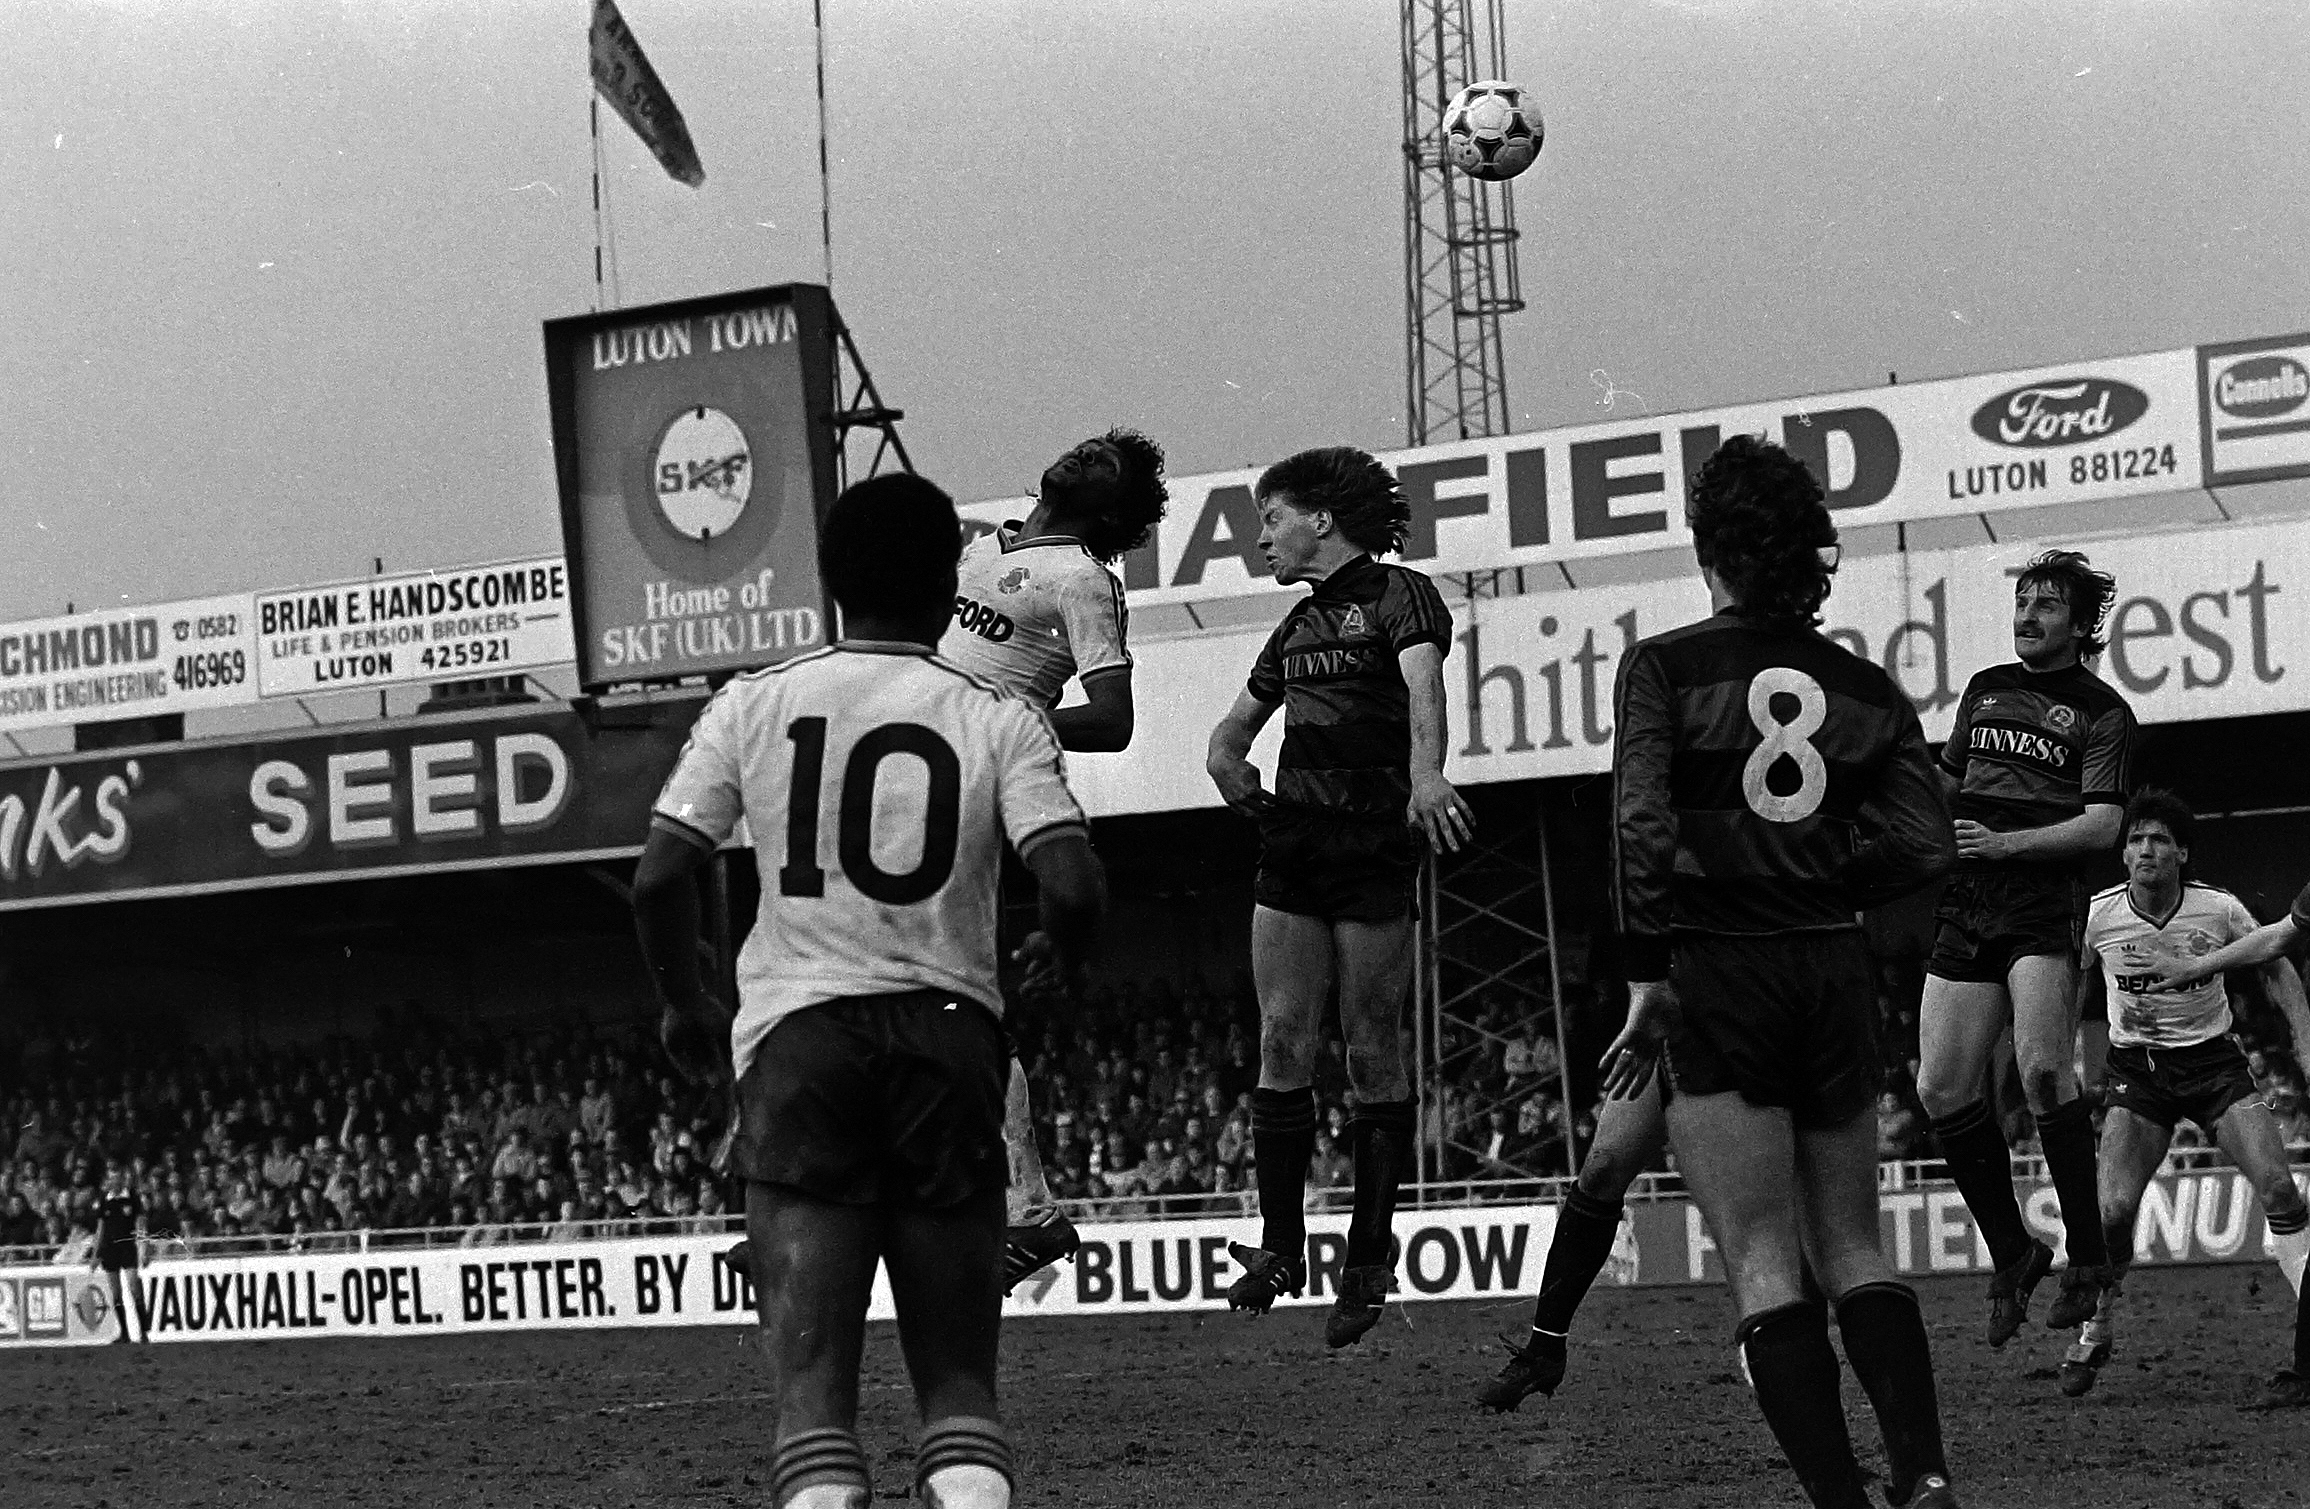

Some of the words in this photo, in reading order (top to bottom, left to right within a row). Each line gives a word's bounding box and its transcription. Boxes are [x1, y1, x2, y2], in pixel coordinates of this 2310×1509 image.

[2000, 382, 2115, 443] Ford
[660, 454, 748, 494] SKF
[1948, 458, 2047, 500] LUTON
[2070, 443, 2177, 486] 881224
[261, 593, 339, 635] BRIAN
[370, 565, 564, 622] HANDSCOMBE
[644, 580, 730, 621] Home
[741, 567, 775, 608] of
[953, 595, 1015, 643] FORD
[0, 618, 159, 677] CHMOND
[199, 613, 237, 639] 0582
[272, 635, 313, 660] LIFE
[319, 633, 333, 654] &
[339, 623, 425, 652] PENSION
[432, 611, 521, 640] BROKERS
[172, 649, 247, 693] 416969
[314, 651, 393, 682] LUTON
[420, 638, 511, 671] 425921
[1742, 666, 1828, 823] 8
[1968, 726, 2070, 768] UINNESS
[250, 732, 573, 853] SEED
[779, 715, 962, 906] 10
[139, 1265, 443, 1334] VAUXHALL-OPEL.
[461, 1257, 616, 1322] BETTER.
[635, 1252, 689, 1314] BY
[1075, 1236, 1230, 1304] BLUE
